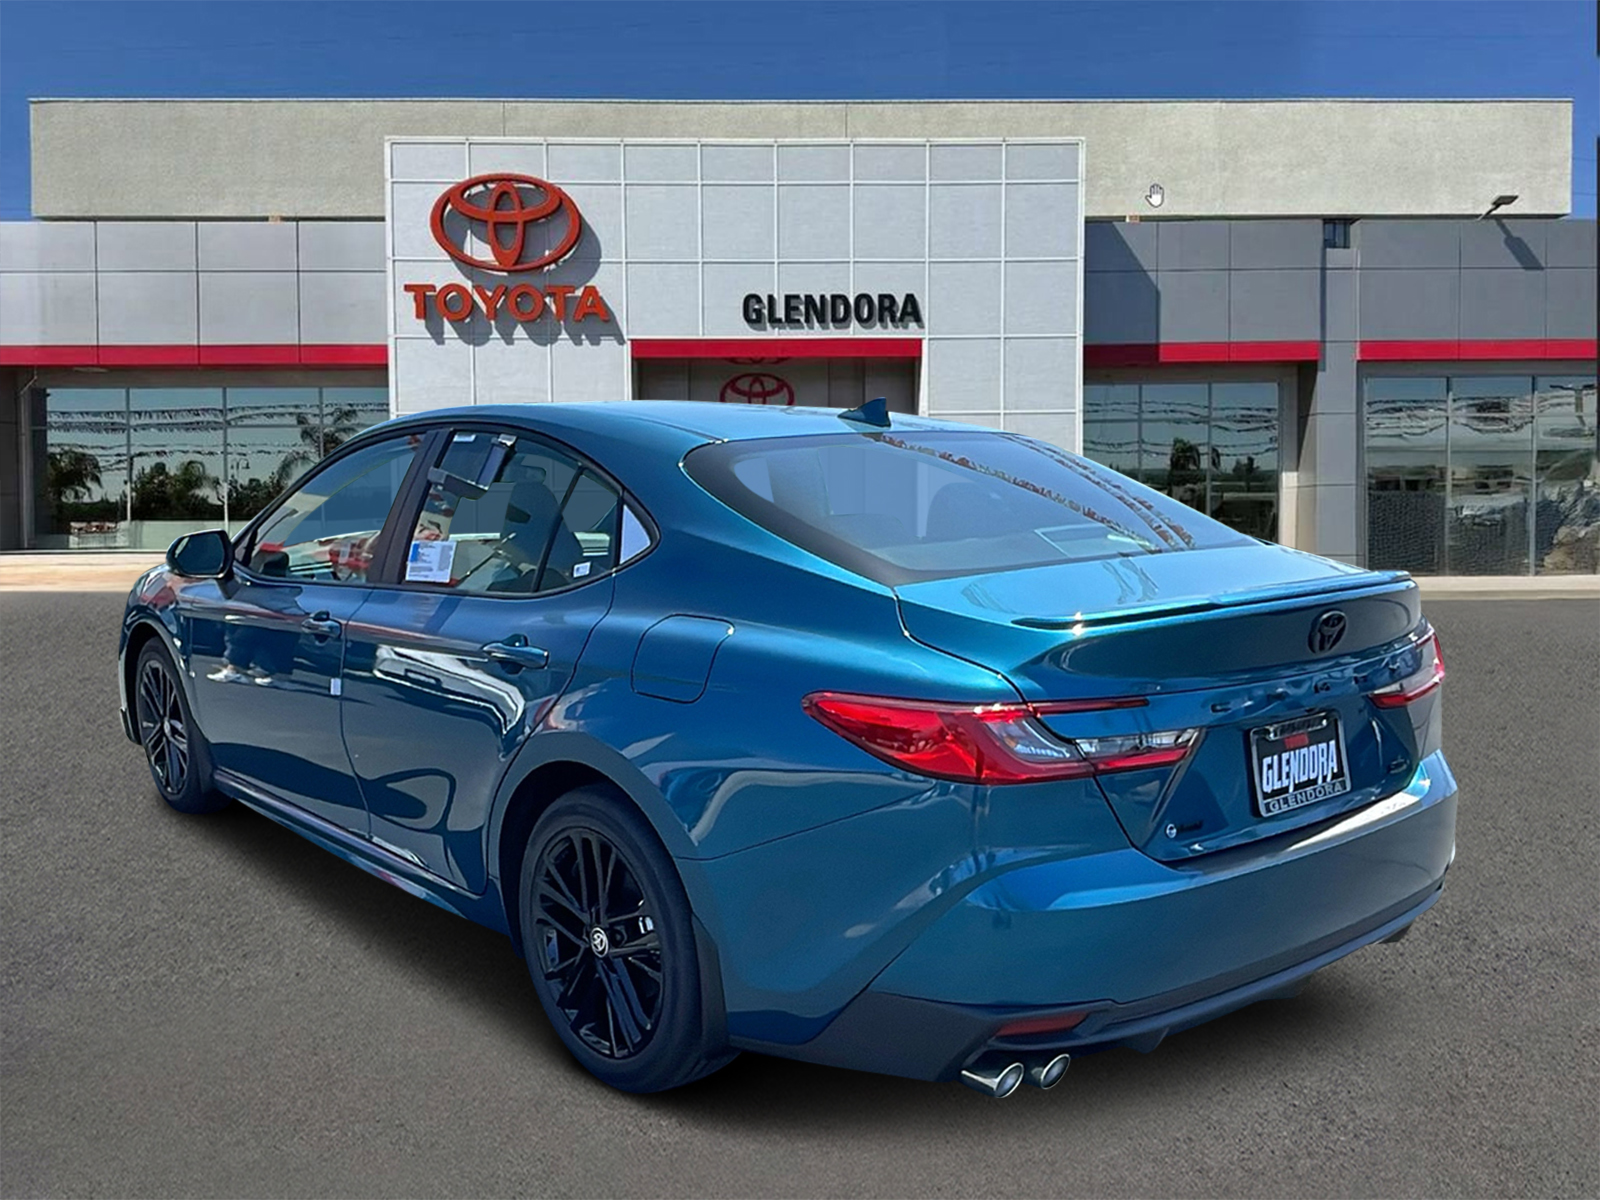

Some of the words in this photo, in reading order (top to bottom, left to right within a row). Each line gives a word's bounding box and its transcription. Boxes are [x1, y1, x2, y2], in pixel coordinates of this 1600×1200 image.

[404, 283, 610, 323] TOYOTA
[743, 292, 923, 326] GLENDORA
[1262, 739, 1338, 794] GLENDORA
[1269, 781, 1343, 812] GLENDORA
